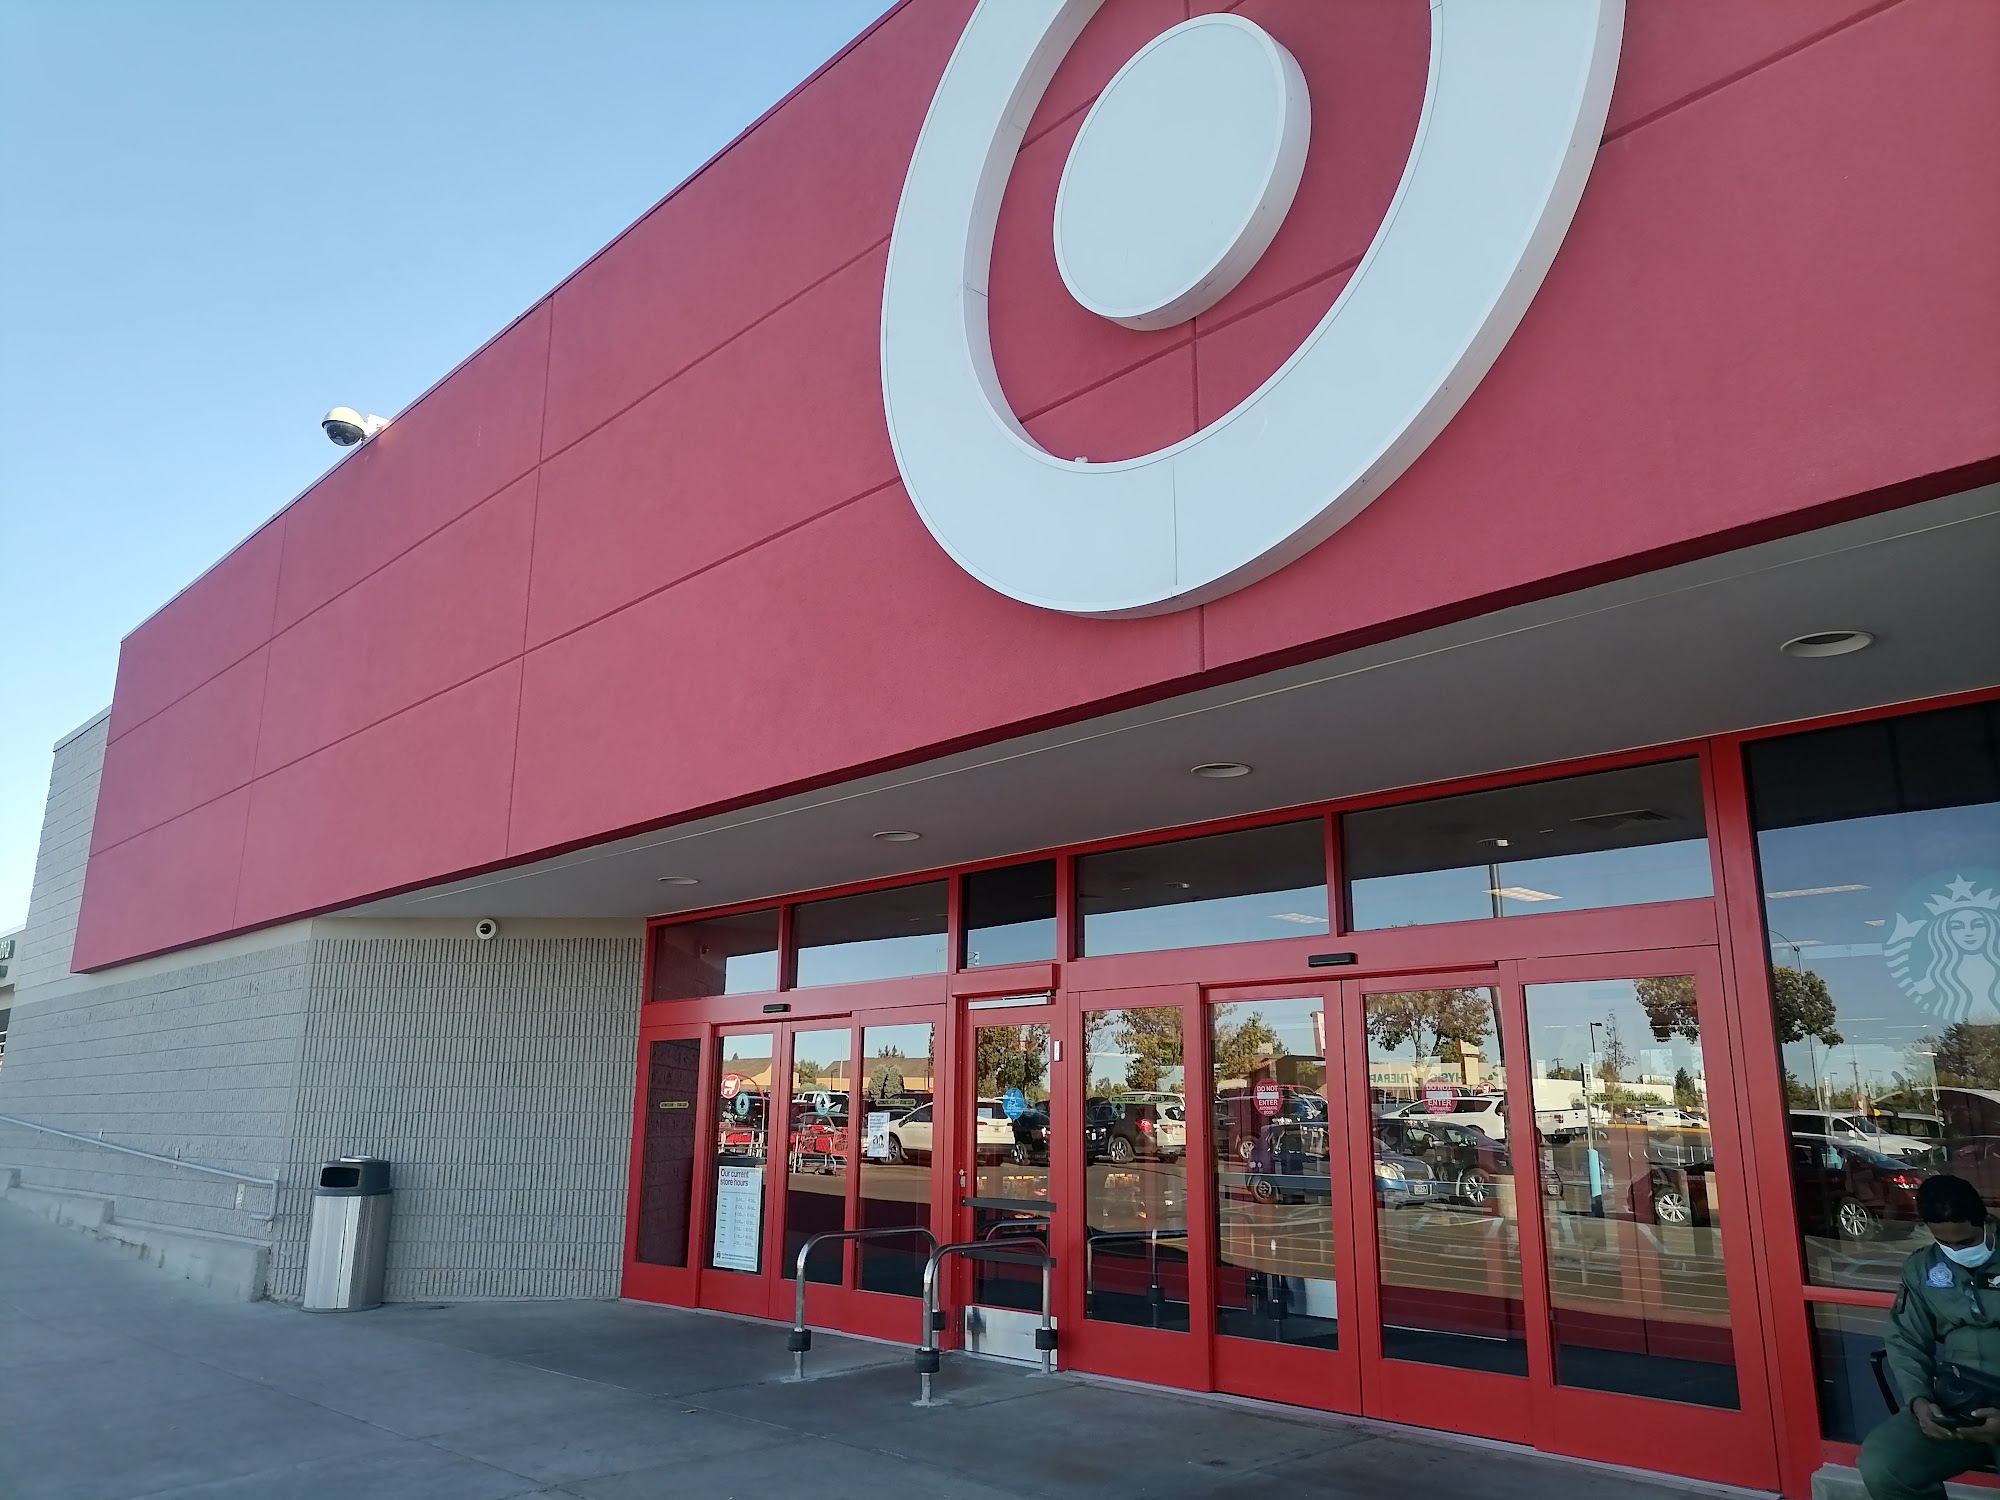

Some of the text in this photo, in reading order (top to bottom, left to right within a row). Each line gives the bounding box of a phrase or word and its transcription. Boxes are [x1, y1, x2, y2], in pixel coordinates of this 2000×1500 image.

[721, 1168, 730, 1177] Our
[720, 1178, 748, 1186] store hours
